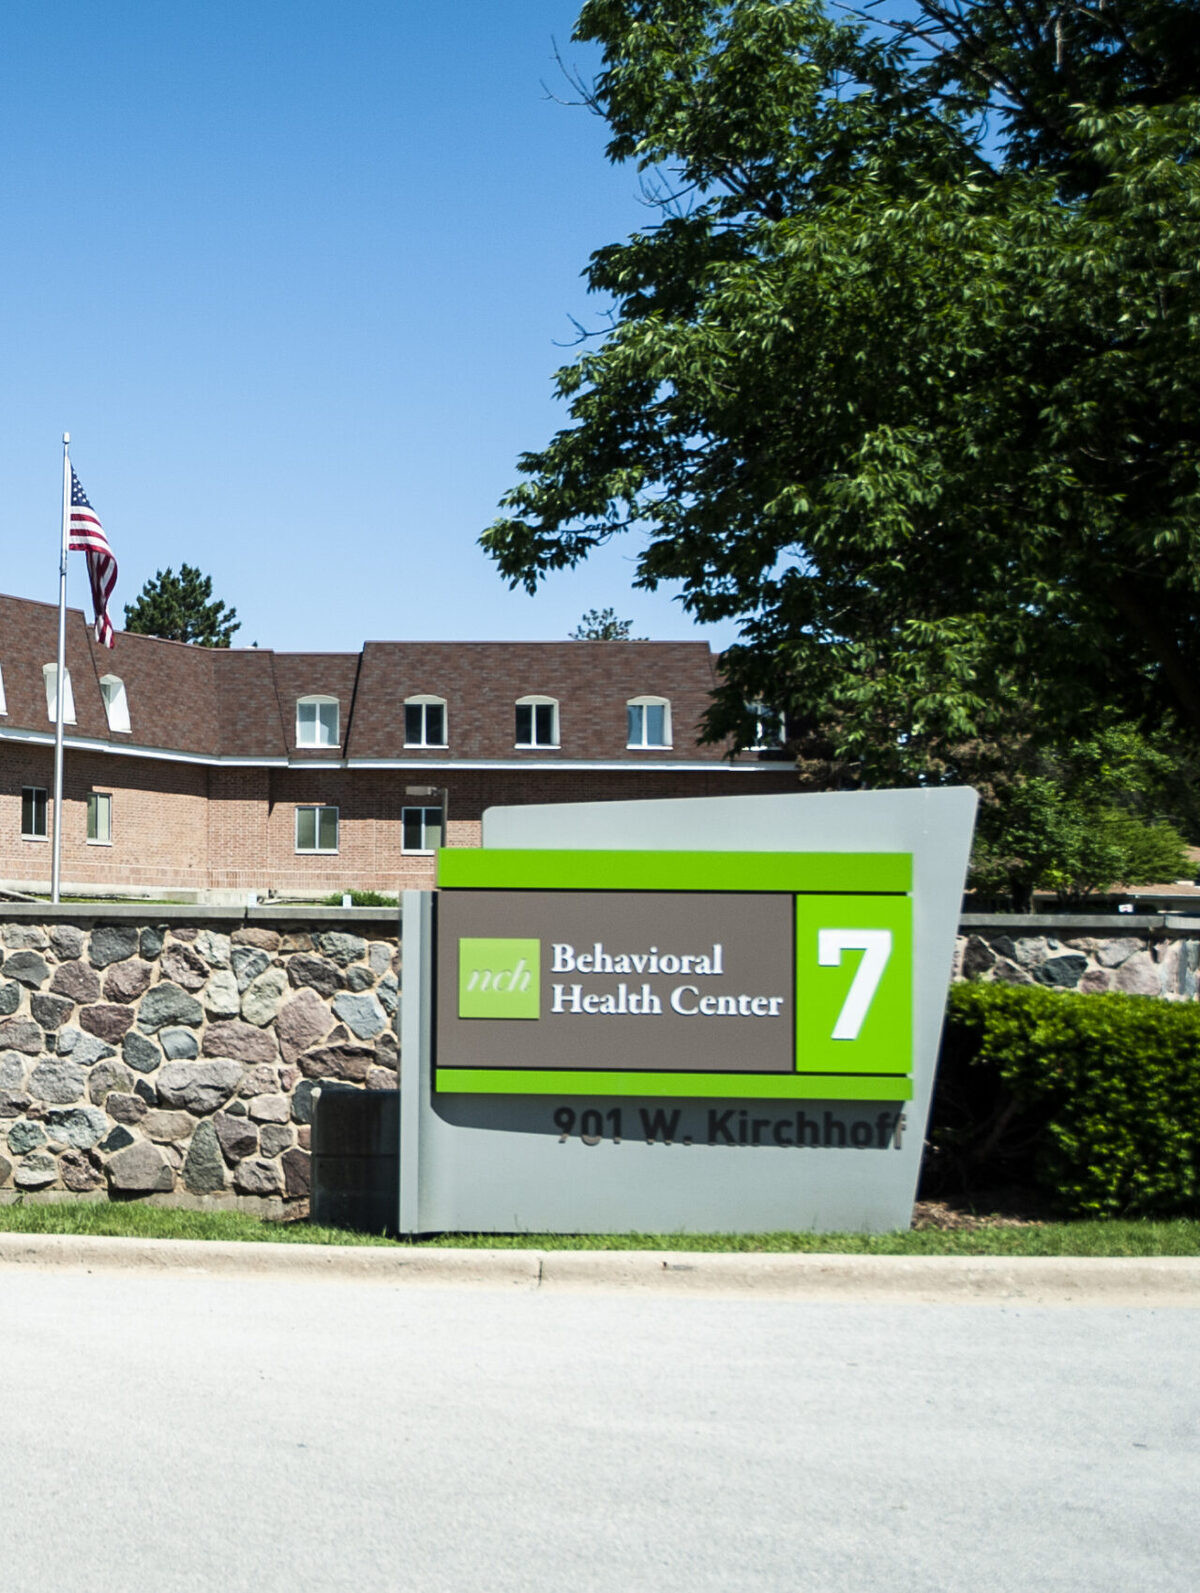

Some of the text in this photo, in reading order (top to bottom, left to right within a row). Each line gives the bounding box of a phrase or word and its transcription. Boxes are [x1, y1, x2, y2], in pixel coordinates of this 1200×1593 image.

[466, 957, 533, 993] nch
[551, 943, 724, 974] Behavioral
[551, 983, 784, 1016] Health Center
[818, 929, 893, 1040] 7
[553, 1107, 907, 1150] 901 W. Kirchhoff
